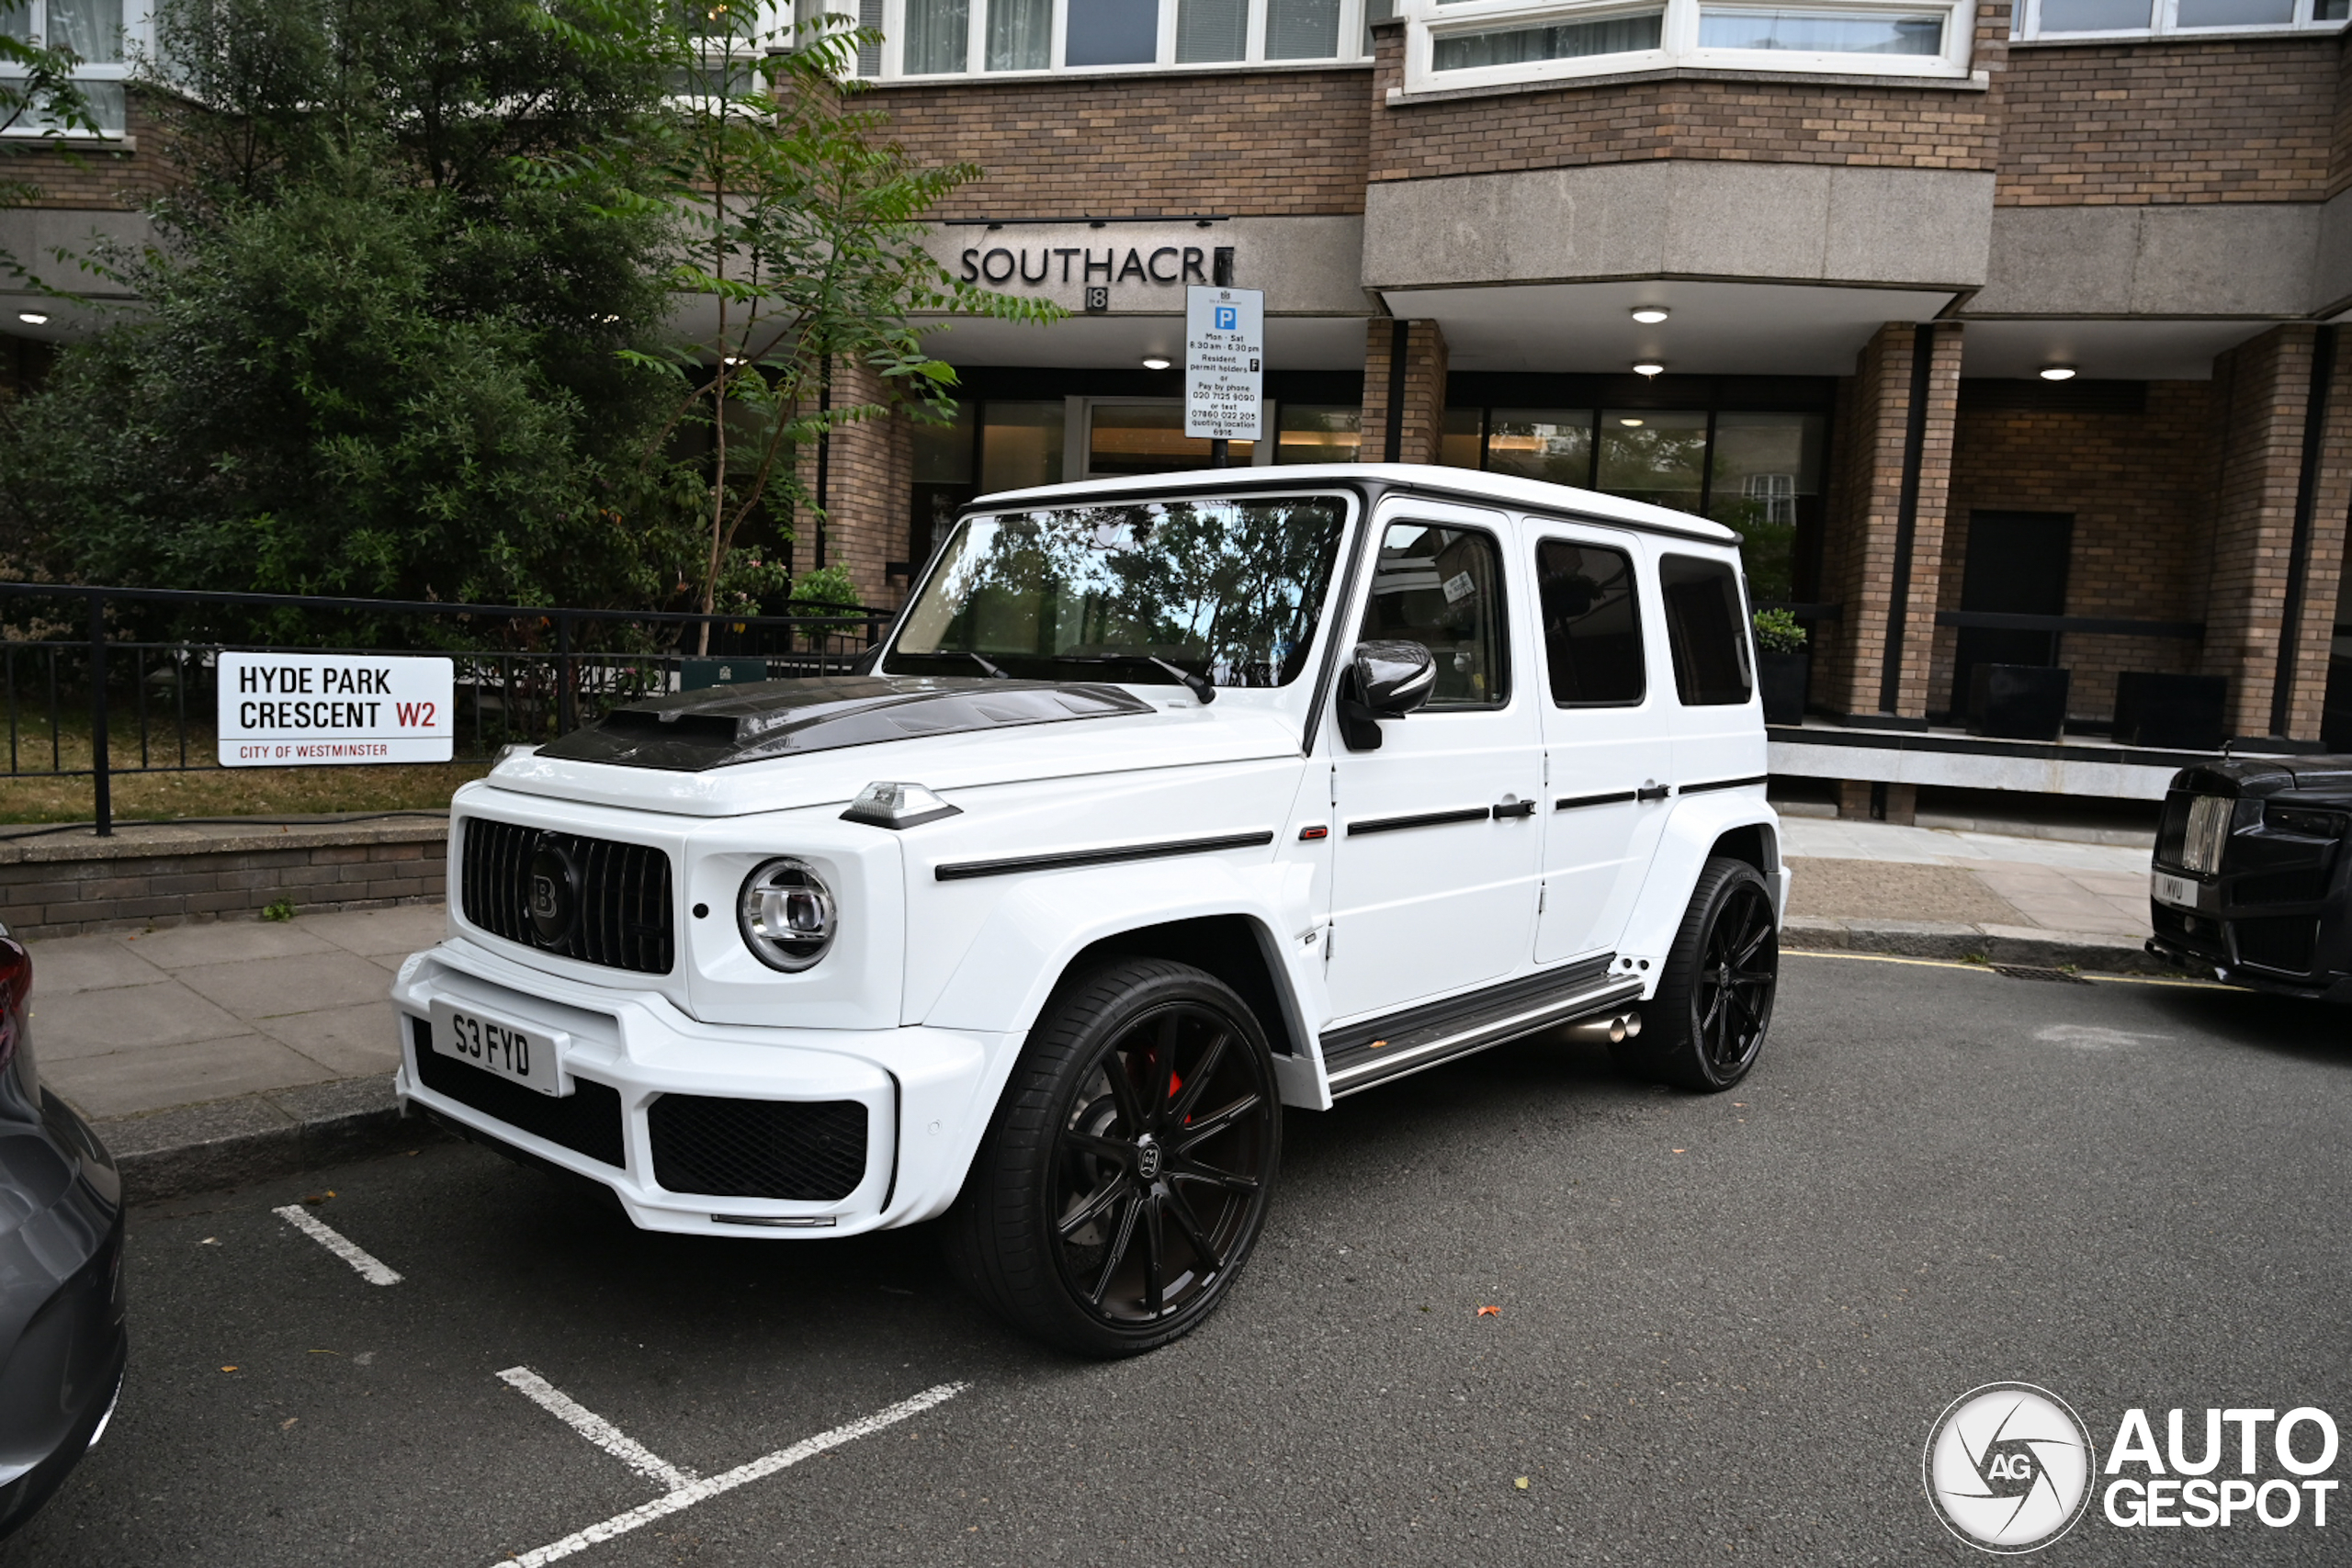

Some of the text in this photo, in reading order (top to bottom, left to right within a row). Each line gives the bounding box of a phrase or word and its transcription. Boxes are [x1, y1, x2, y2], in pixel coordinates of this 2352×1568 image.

[1088, 288, 1106, 309] 18
[1220, 310, 1233, 327] P
[1231, 333, 1244, 342] Sat
[1202, 354, 1237, 363] Resident
[1199, 382, 1212, 390] Pay
[1227, 384, 1250, 392] phone
[1192, 419, 1222, 427] quoting
[240, 666, 390, 694] HYDE PARK
[241, 702, 436, 728] CRESCENT W2
[240, 744, 388, 758] CITY OF WESTMINSTER
[453, 1014, 529, 1076] S3 FYD
